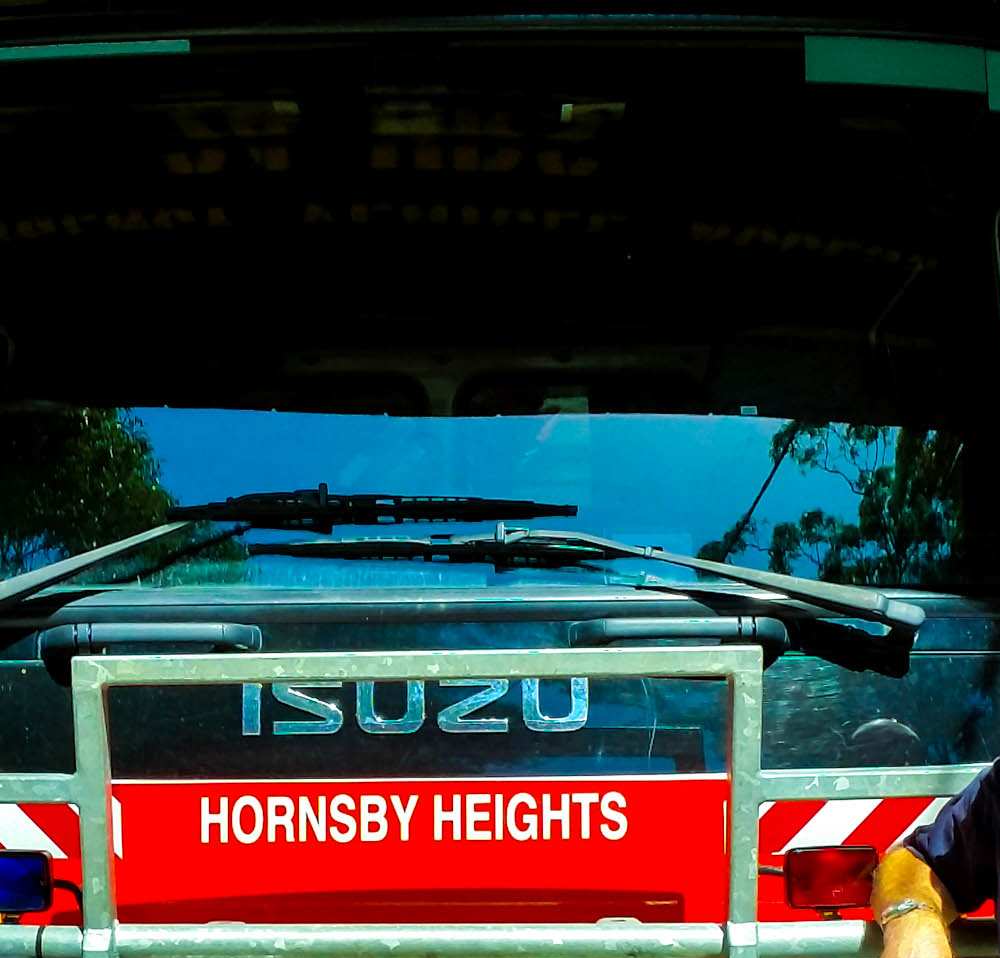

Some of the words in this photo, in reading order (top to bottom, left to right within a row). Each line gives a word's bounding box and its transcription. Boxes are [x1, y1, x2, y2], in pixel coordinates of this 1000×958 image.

[241, 677, 590, 736] ISUZU
[200, 794, 419, 844] HORNSBY
[433, 791, 628, 841] HEIGHTS
